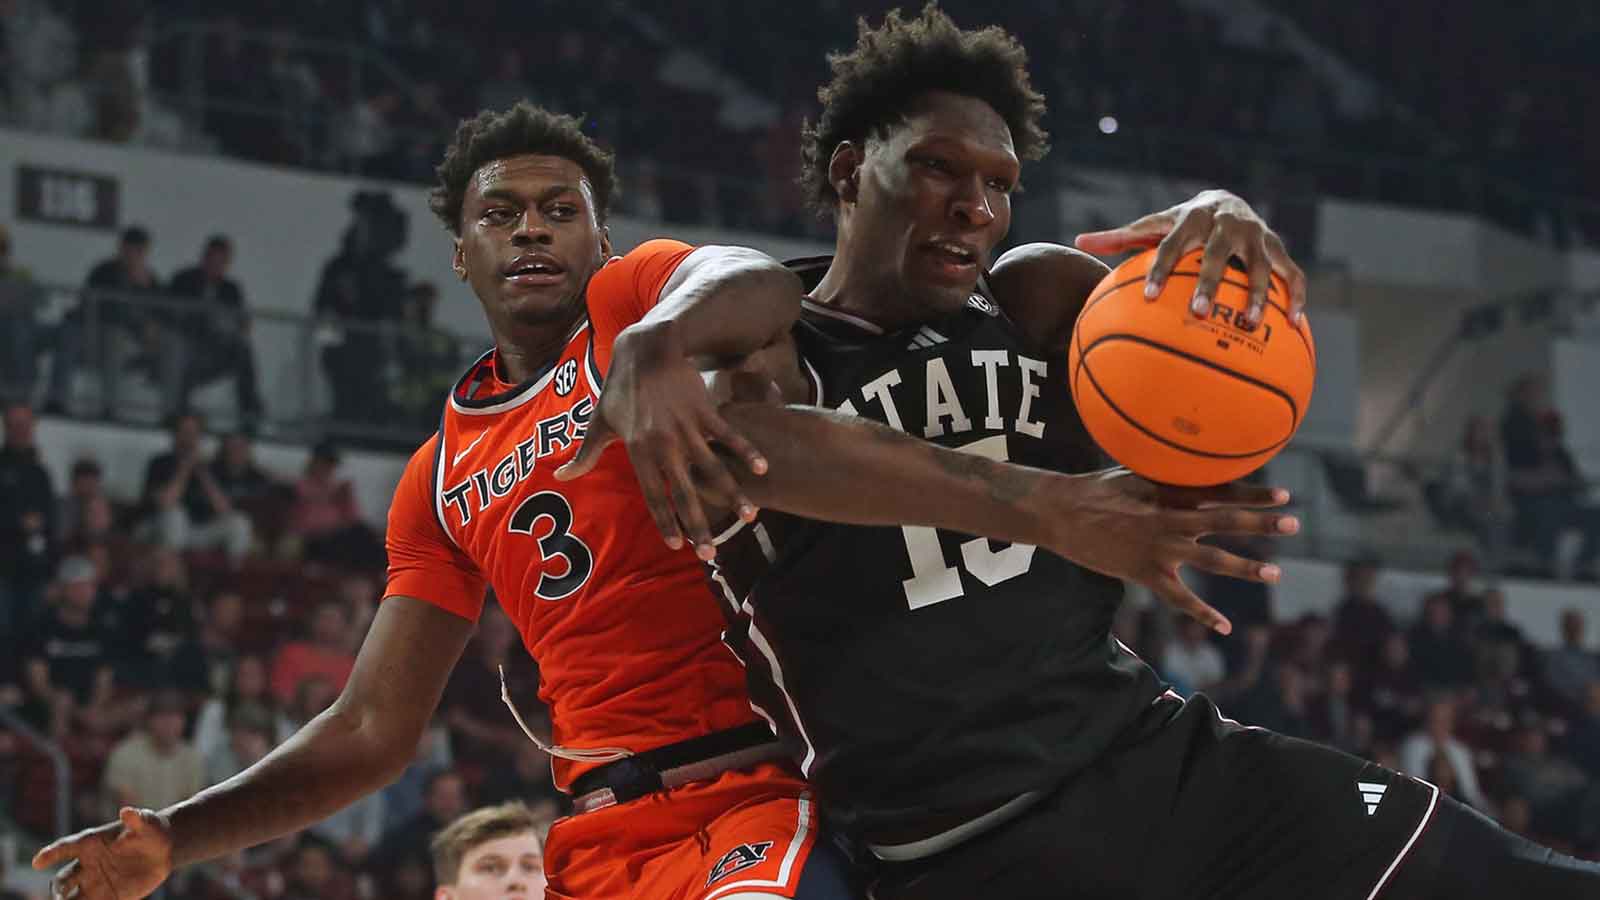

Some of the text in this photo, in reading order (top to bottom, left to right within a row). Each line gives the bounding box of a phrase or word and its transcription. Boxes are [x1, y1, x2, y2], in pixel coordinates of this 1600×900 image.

[554, 360, 577, 396] SEC
[835, 349, 1049, 439] TATE
[443, 394, 595, 527] TIGERS
[508, 490, 593, 600] 3
